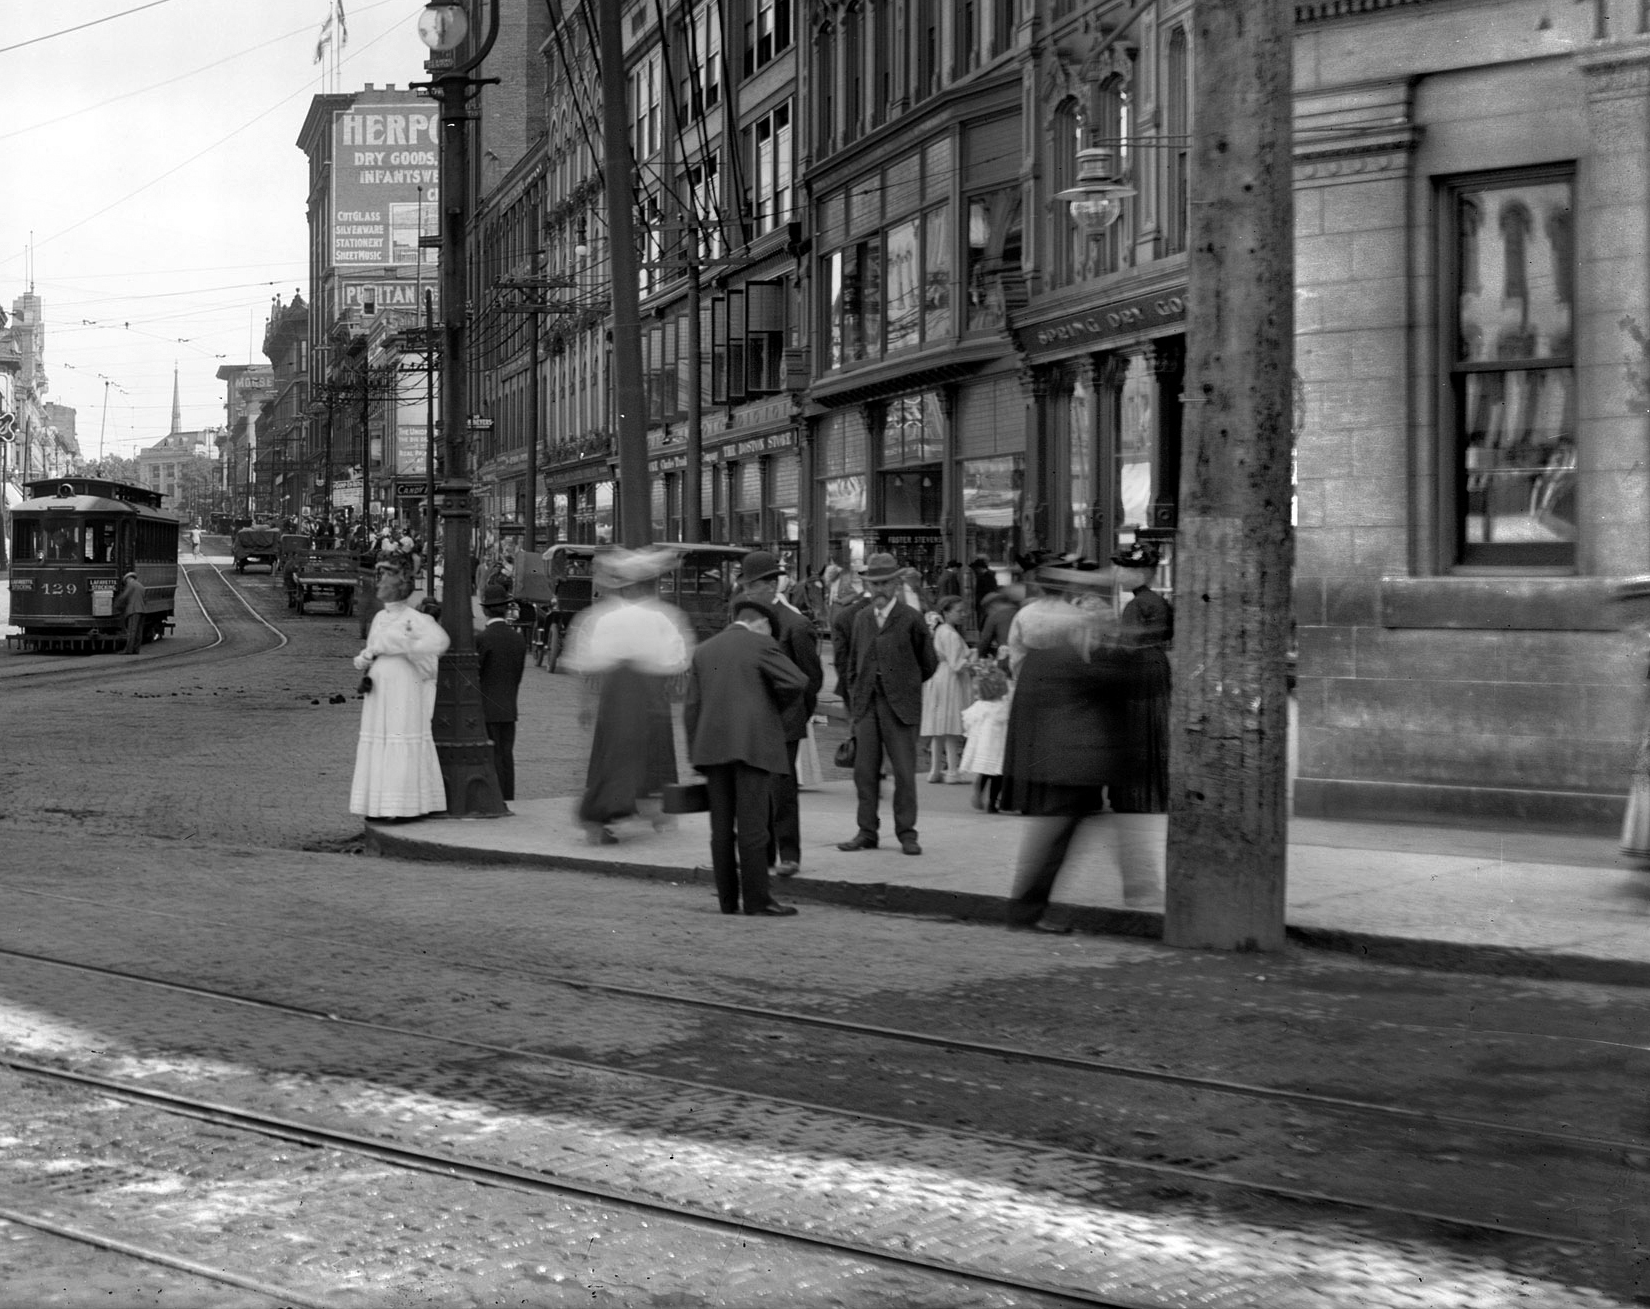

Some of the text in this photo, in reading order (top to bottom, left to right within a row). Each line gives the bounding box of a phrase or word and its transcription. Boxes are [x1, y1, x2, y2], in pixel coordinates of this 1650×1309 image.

[354, 152, 386, 166] DRY
[335, 224, 384, 235] SILVERWARE
[335, 237, 384, 248] STATIONERY
[1037, 318, 1102, 346] SPRING
[1105, 307, 1145, 327] DRY
[235, 376, 273, 388] MORSE
[738, 438, 765, 455] BOSTON
[887, 536, 912, 544] FOSTER
[40, 583, 77, 595] 129
